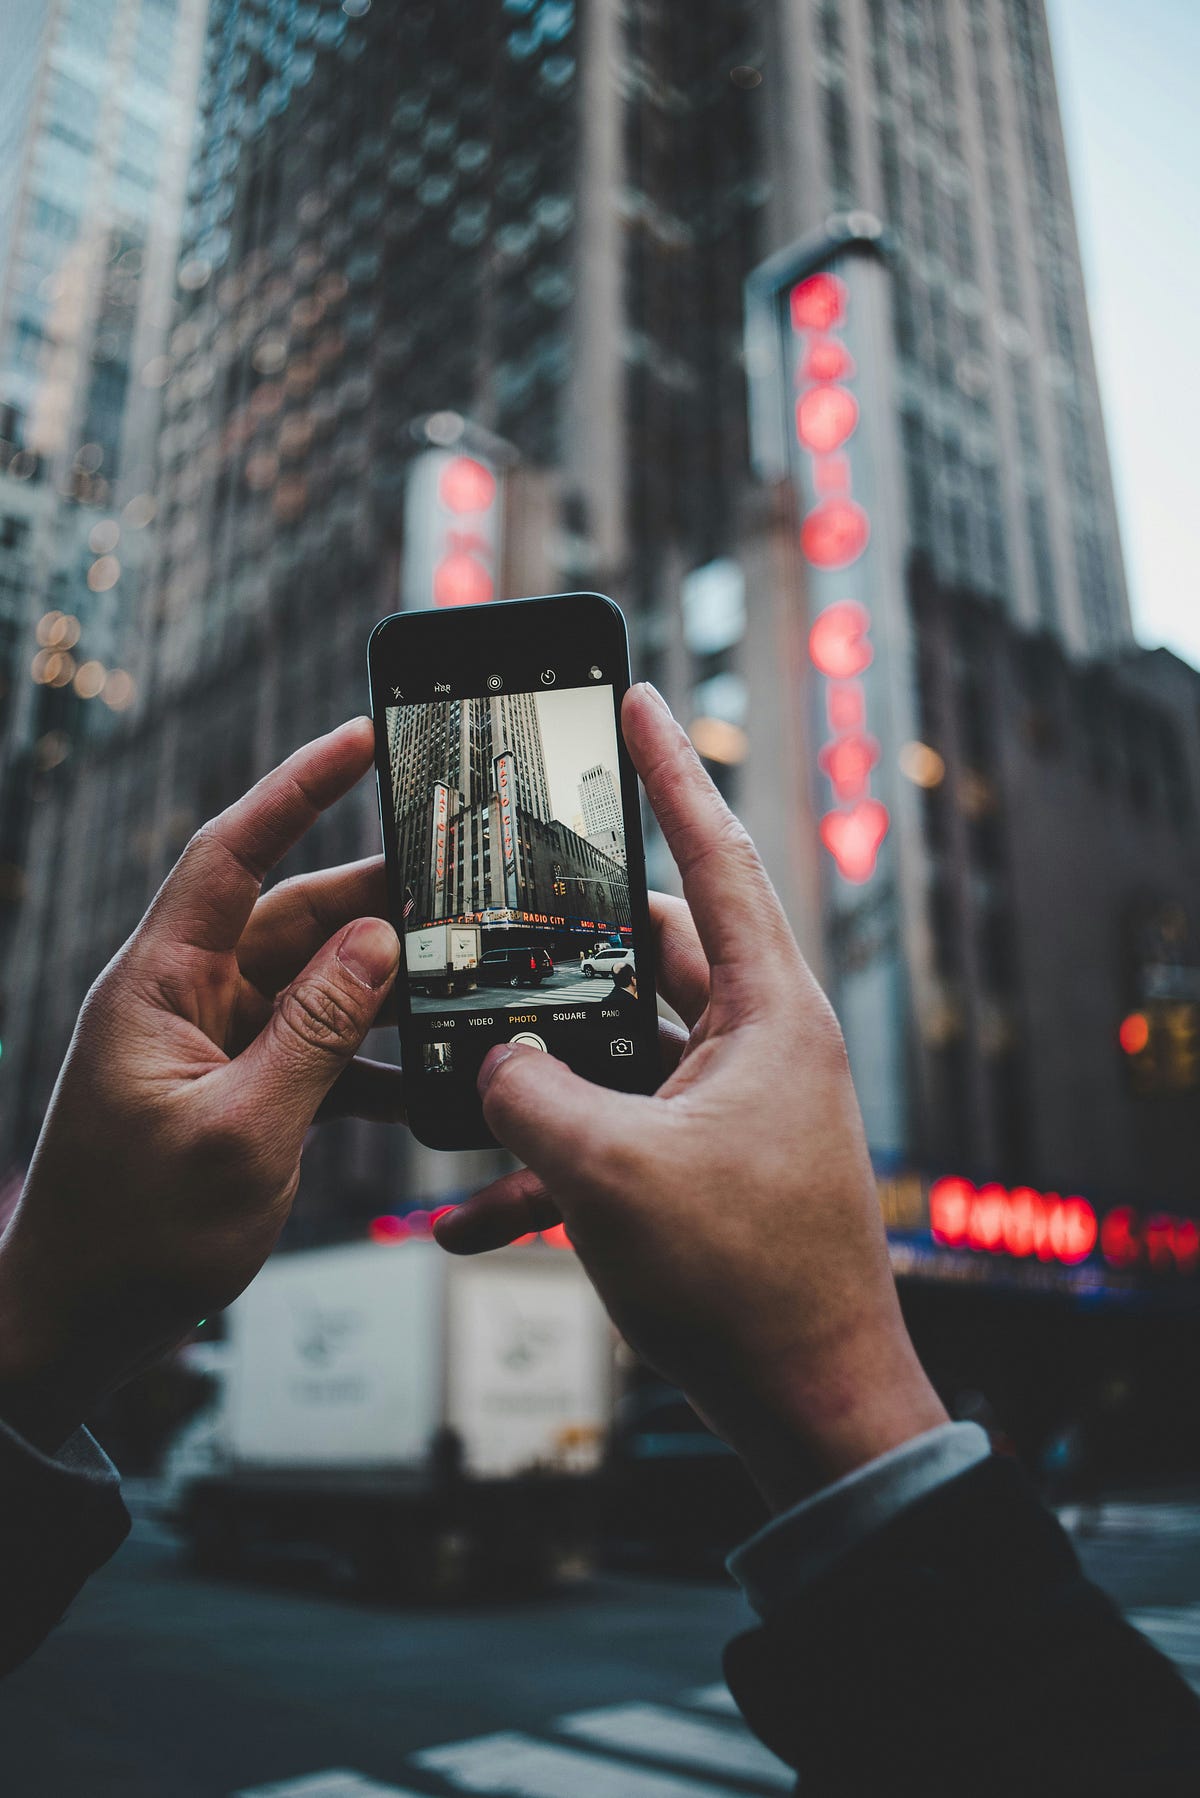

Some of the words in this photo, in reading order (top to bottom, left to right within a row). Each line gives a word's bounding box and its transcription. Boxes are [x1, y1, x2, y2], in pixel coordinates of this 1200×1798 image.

[434, 683, 451, 693] HDR
[498, 759, 510, 807] RADIO
[437, 788, 447, 832] RADIO
[502, 815, 513, 860] CITY
[436, 839, 445, 878] CITY
[522, 911, 548, 924] RADIO
[549, 916, 566, 925] CITY
[468, 1017, 494, 1026] VIDEO
[508, 1014, 538, 1024] PHOTO
[552, 1011, 587, 1021] SQUARE
[601, 1009, 620, 1018] PANO
